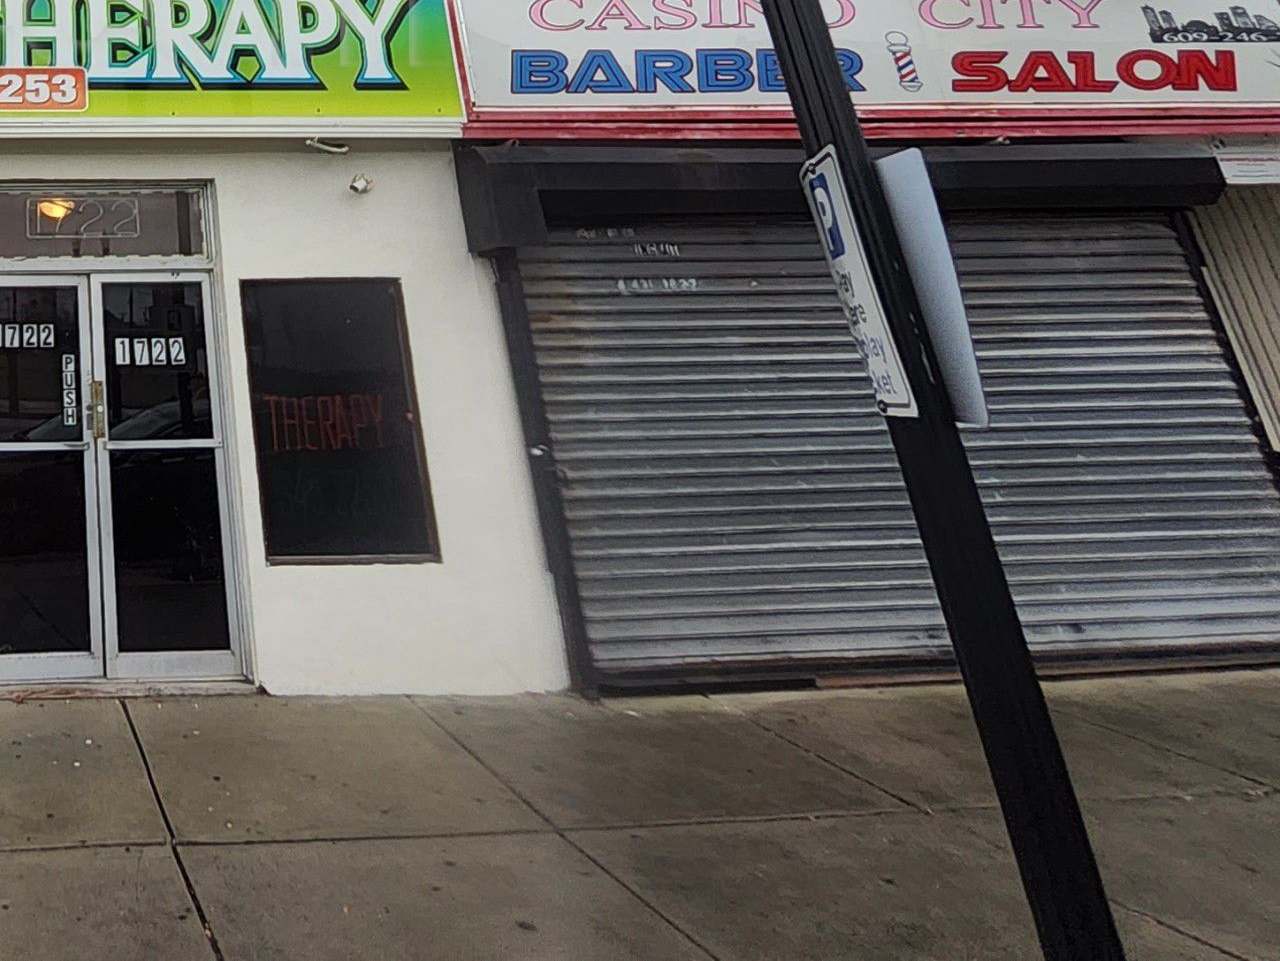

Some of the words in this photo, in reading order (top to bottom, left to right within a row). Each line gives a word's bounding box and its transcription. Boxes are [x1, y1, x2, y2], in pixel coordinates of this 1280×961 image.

[951, 49, 1238, 94] SALON
[116, 338, 185, 365] 1722
[62, 355, 77, 426] PUSH
[263, 393, 384, 454] THERAPY
